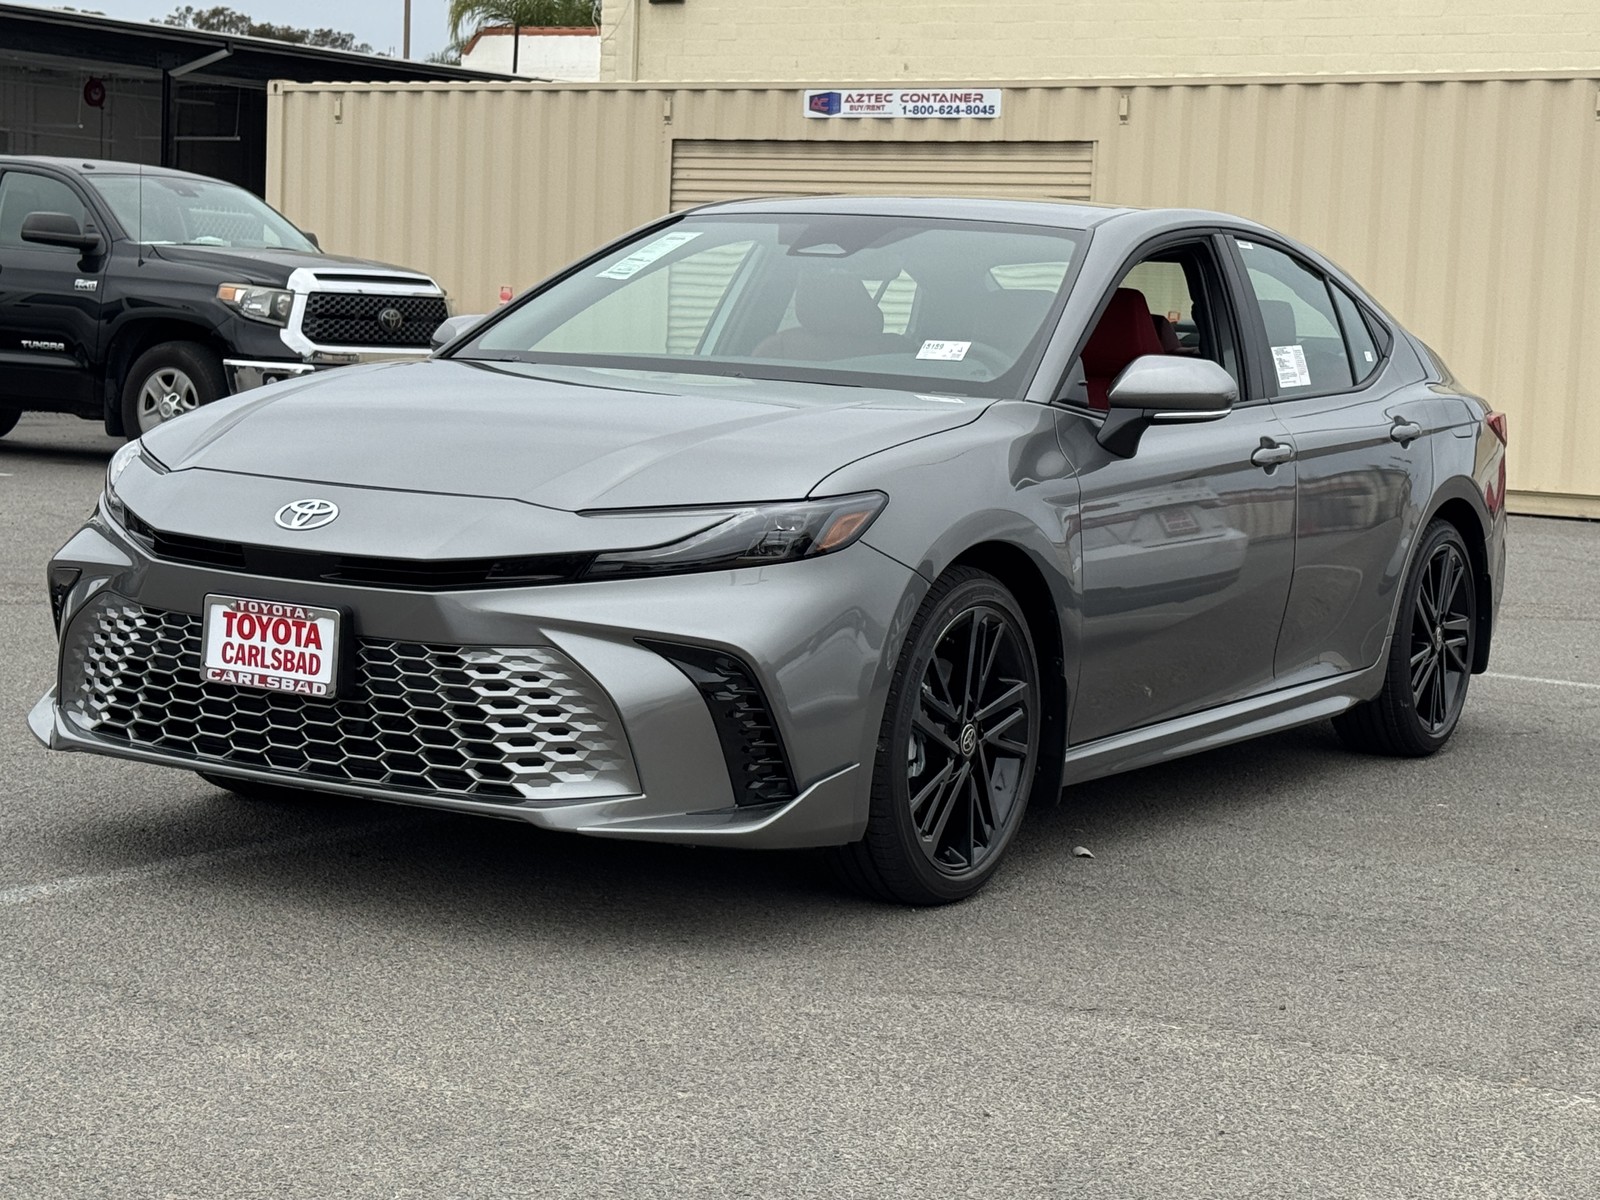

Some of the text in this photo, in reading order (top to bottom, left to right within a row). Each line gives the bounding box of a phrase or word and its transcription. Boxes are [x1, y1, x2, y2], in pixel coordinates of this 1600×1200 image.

[843, 93, 984, 103] AZTEC CONTAINER
[849, 104, 886, 112] BUY/RENT
[902, 105, 995, 115] 1-800-624-8045
[21, 340, 65, 351] TUNDRA
[238, 601, 306, 619] TOYOTA
[222, 611, 322, 650] TOYOTA
[221, 641, 321, 675] CARLSBAD
[206, 668, 327, 695] CARLSBAD
